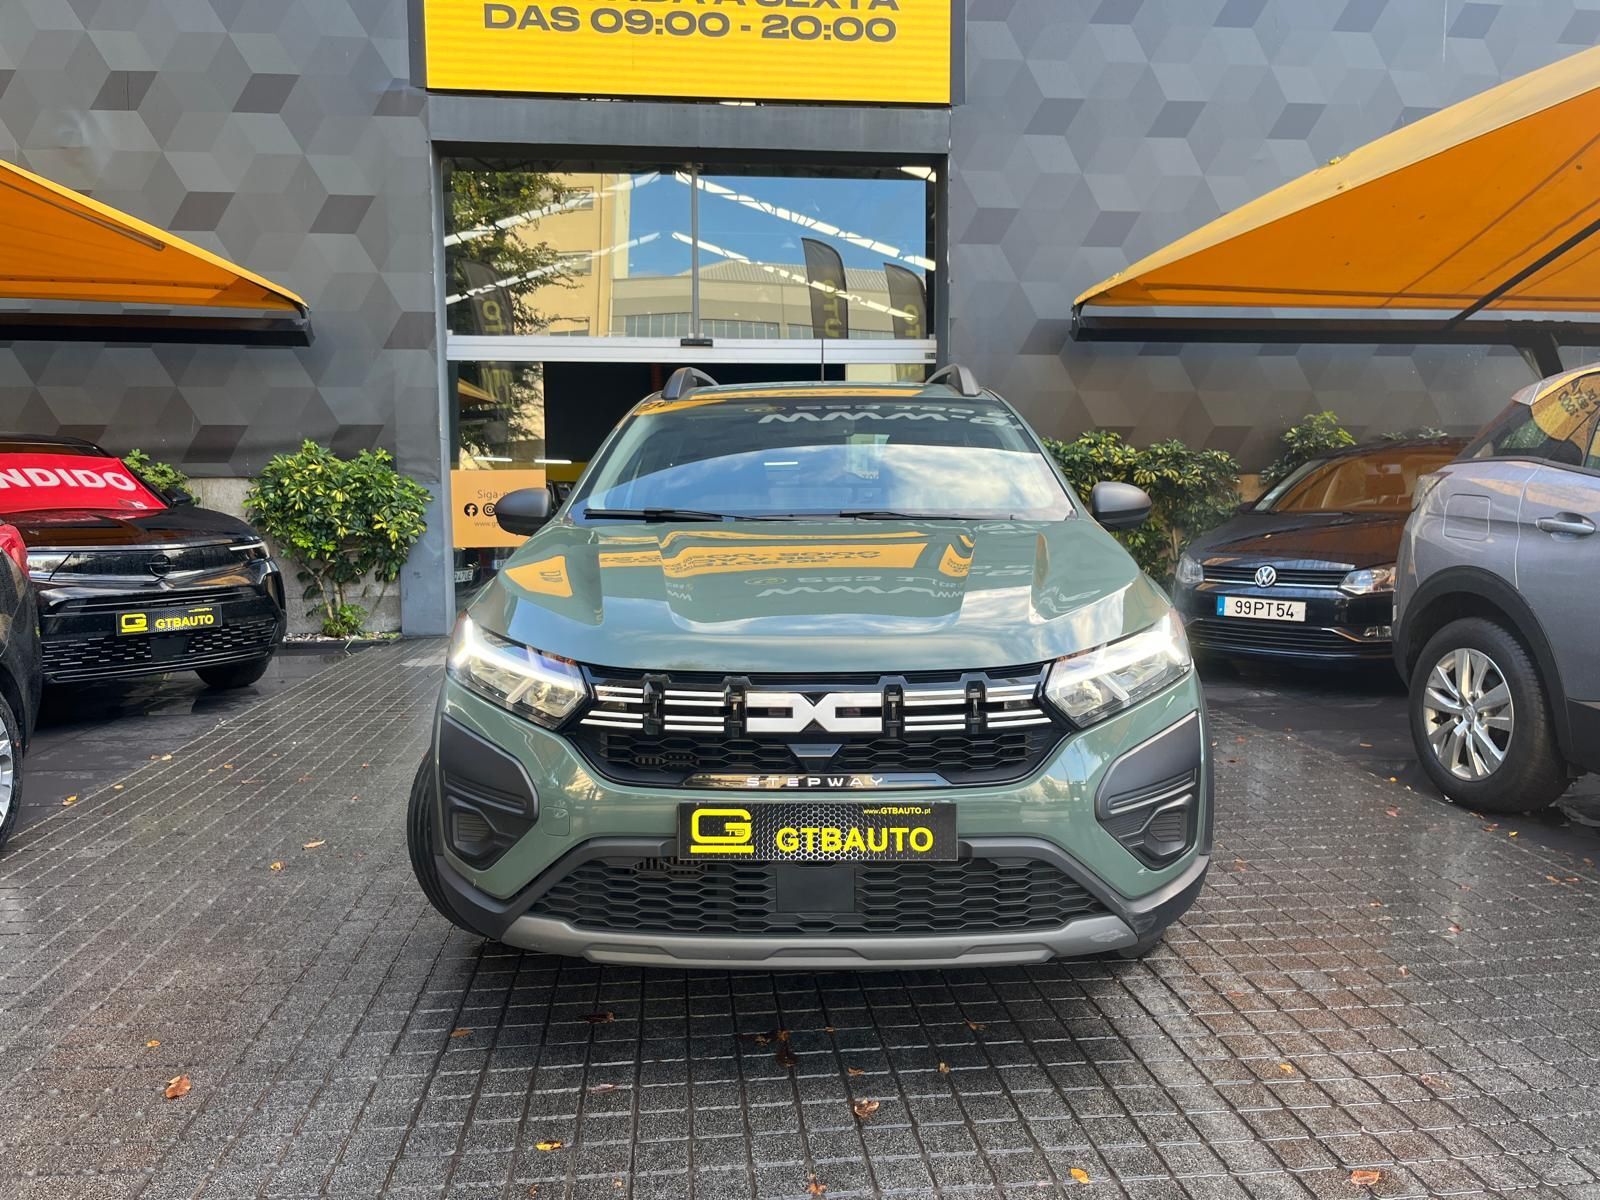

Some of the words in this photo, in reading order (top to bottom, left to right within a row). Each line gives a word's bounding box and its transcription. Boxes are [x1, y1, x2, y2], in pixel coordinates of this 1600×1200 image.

[484, 3, 580, 32] DAS
[591, 8, 730, 37] 09:00
[761, 14, 897, 42] 20:00
[155, 614, 214, 629] GTBAUTO
[747, 776, 883, 787] STEPWAY
[863, 807, 931, 815] www.GTBAUTO.pt
[776, 827, 935, 852] GTBAUTO
